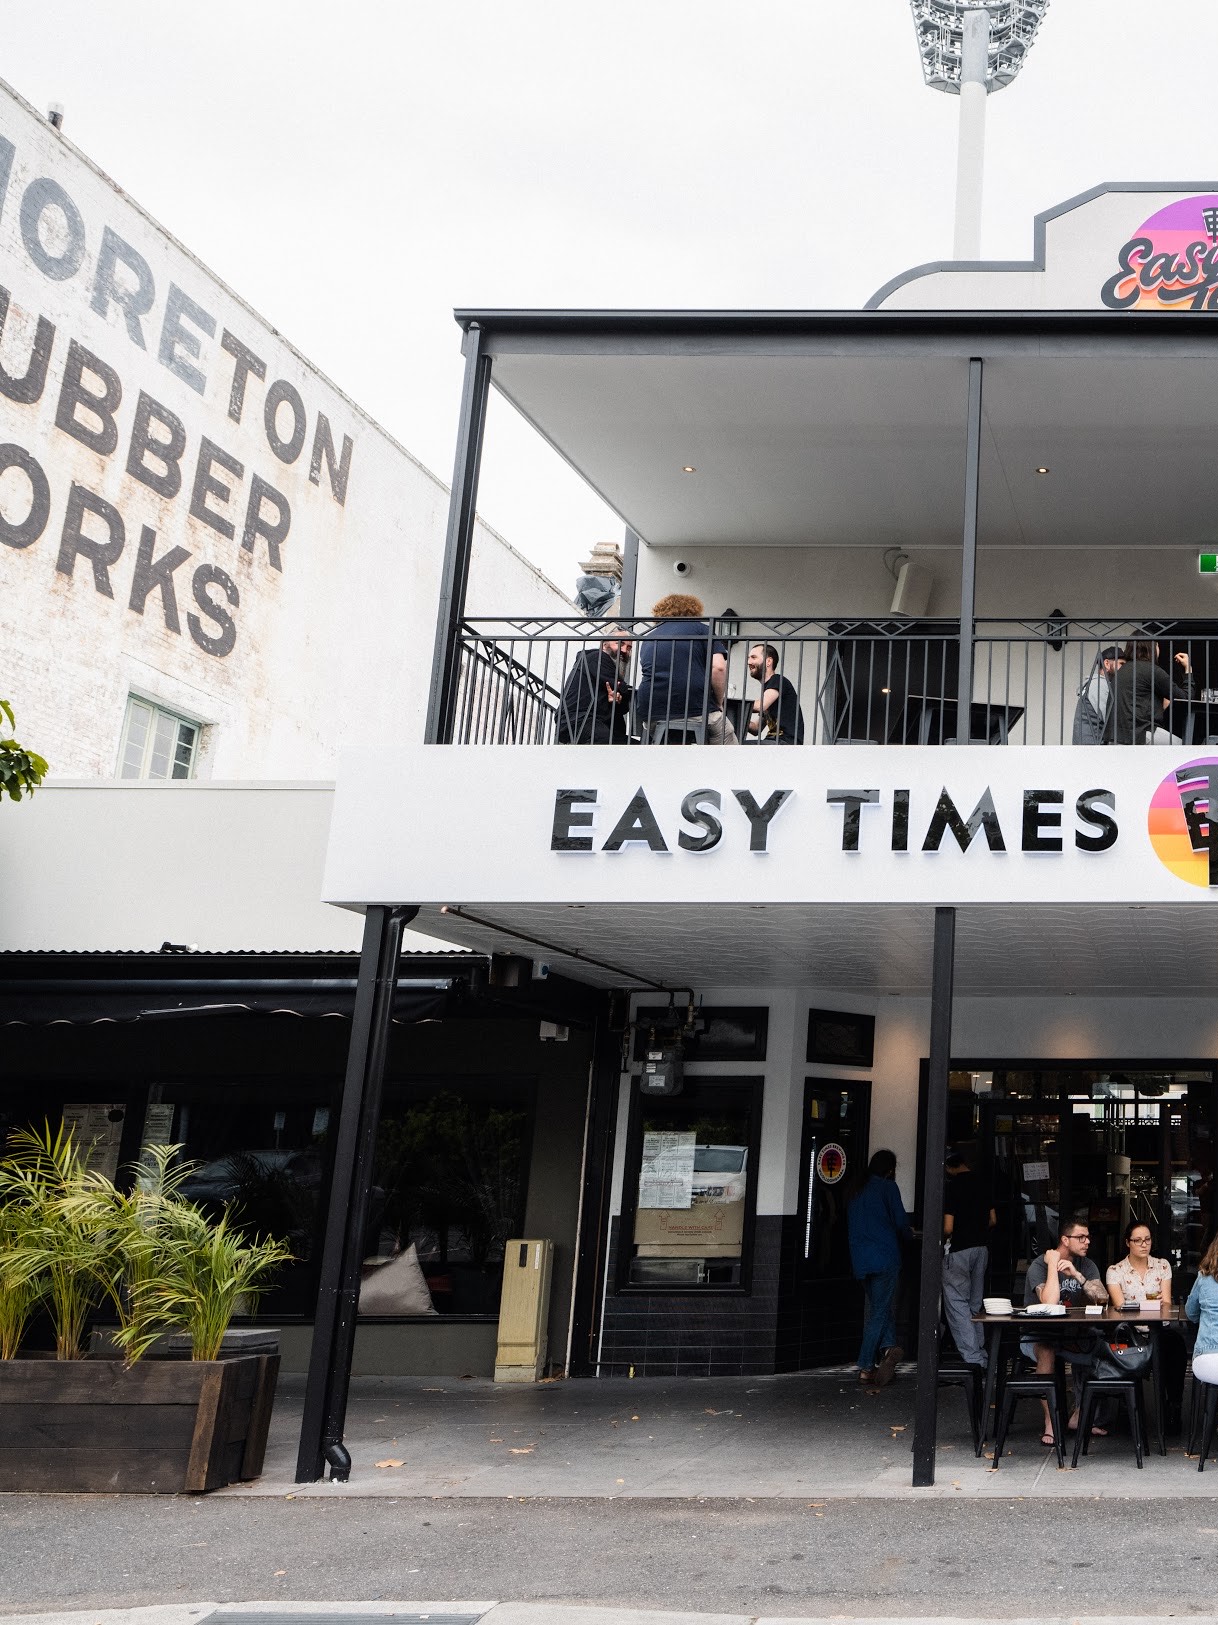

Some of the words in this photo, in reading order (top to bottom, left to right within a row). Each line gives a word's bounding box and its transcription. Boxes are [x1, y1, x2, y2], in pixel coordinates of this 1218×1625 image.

[0, 133, 355, 507] ORETON
[550, 785, 794, 854] EASY
[826, 785, 1118, 854] TIMES
